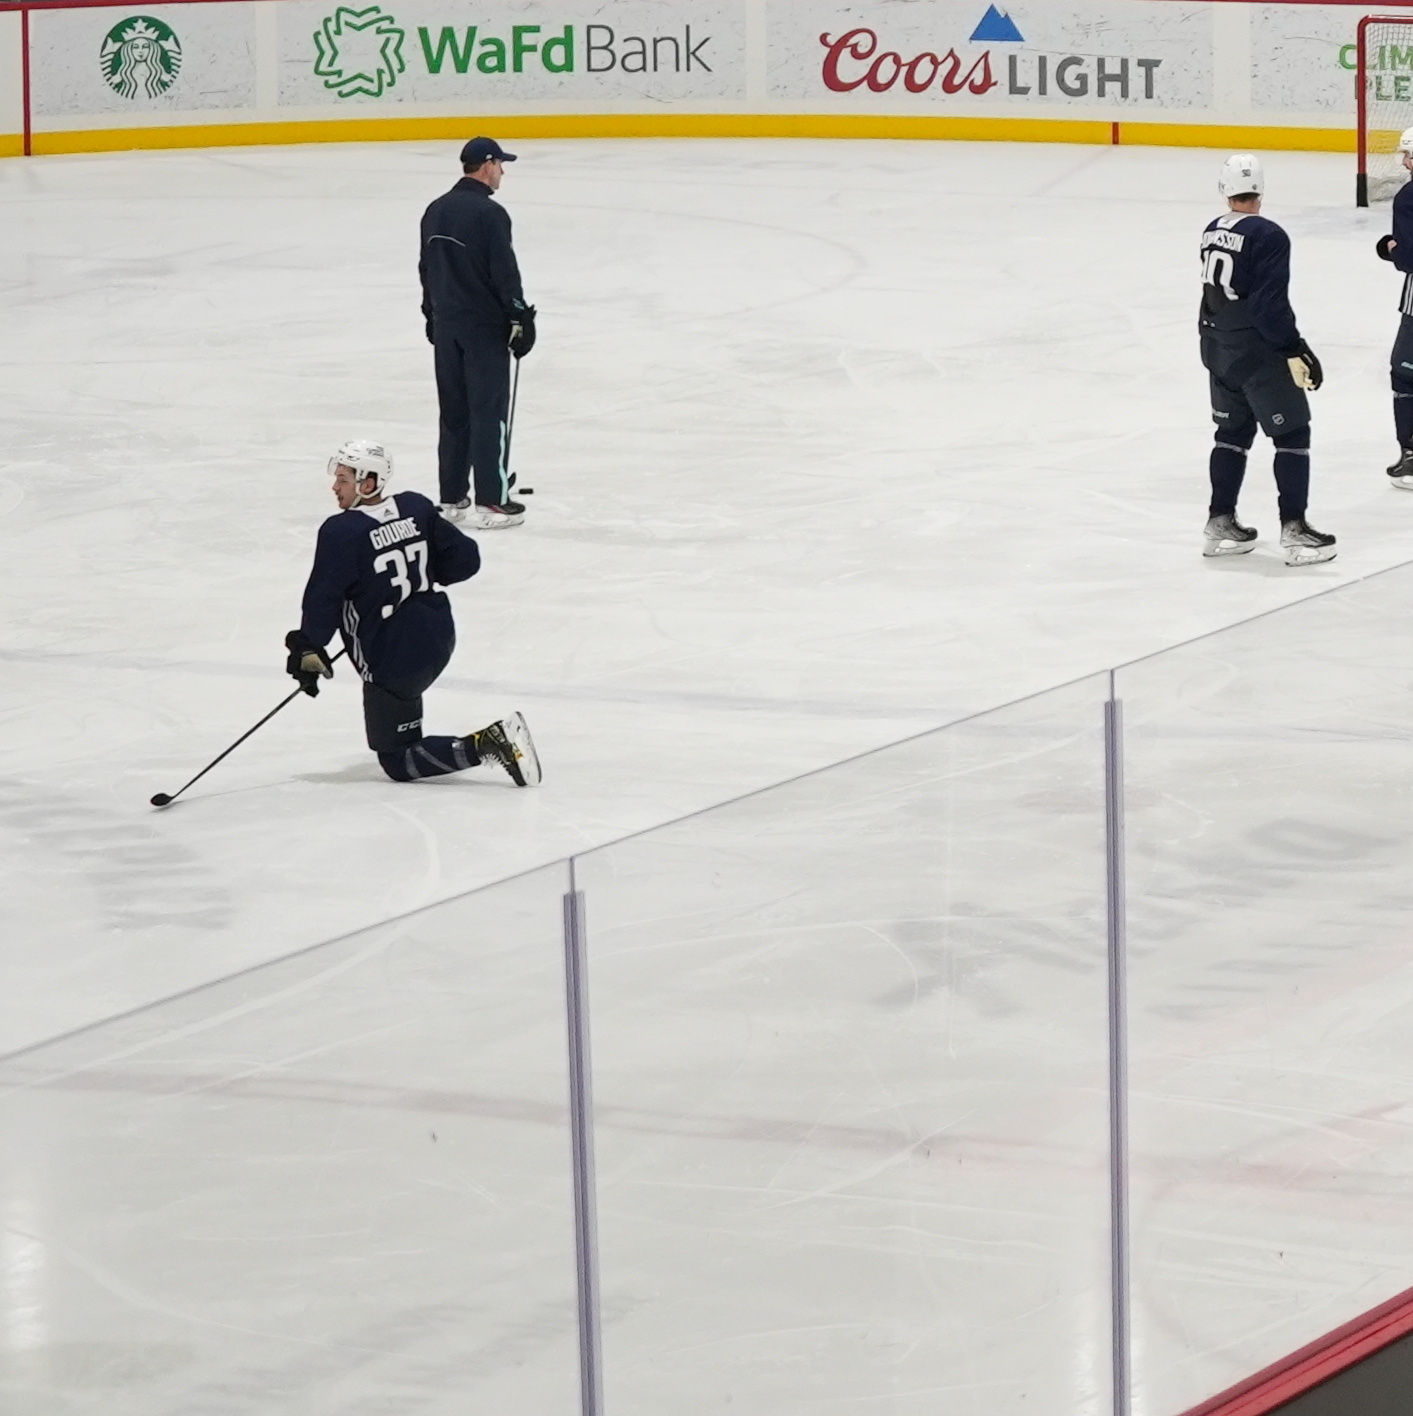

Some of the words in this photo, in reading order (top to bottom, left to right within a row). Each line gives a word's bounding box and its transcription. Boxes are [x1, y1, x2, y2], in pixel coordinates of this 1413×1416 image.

[417, 24, 575, 75] WaFd
[585, 24, 714, 74] Bank
[819, 27, 998, 95] Coors
[1008, 54, 1163, 100] LIGHT
[369, 517, 421, 551] GOURDE
[373, 539, 431, 620] 37
[397, 719, 423, 733] CC
